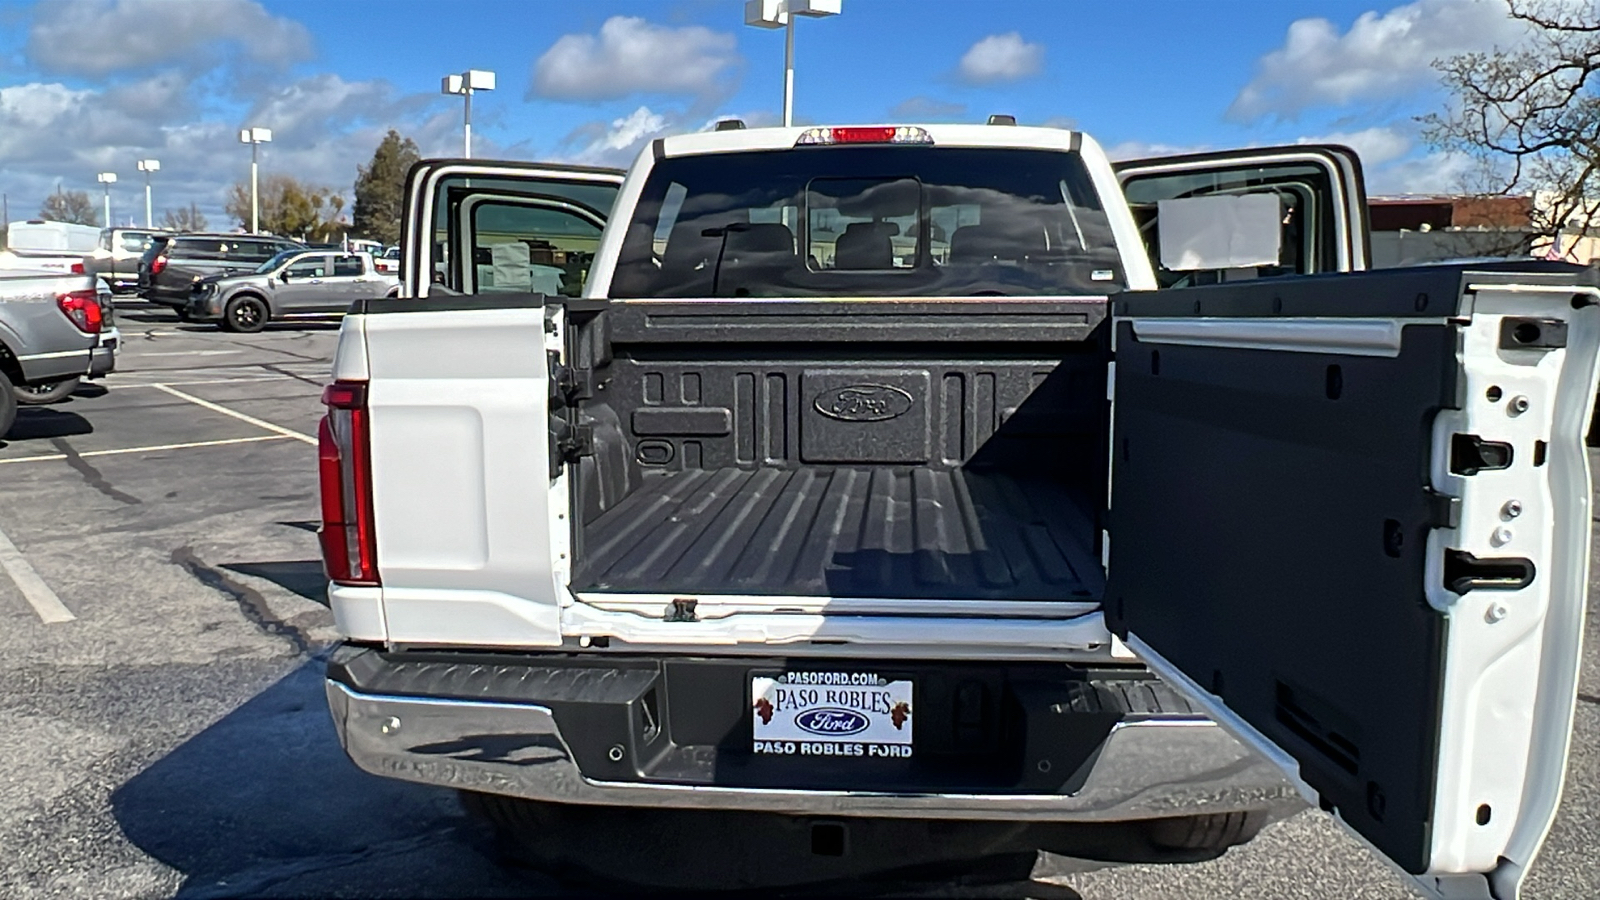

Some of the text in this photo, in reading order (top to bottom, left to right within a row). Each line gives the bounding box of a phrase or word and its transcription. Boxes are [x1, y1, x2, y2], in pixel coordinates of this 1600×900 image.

[831, 388, 894, 414] Ford
[787, 672, 878, 685] PASOFORD.COM
[776, 688, 891, 715] PASO ROBLES
[809, 712, 857, 732] Ford
[753, 742, 913, 758] PASO ROBLES FORD
